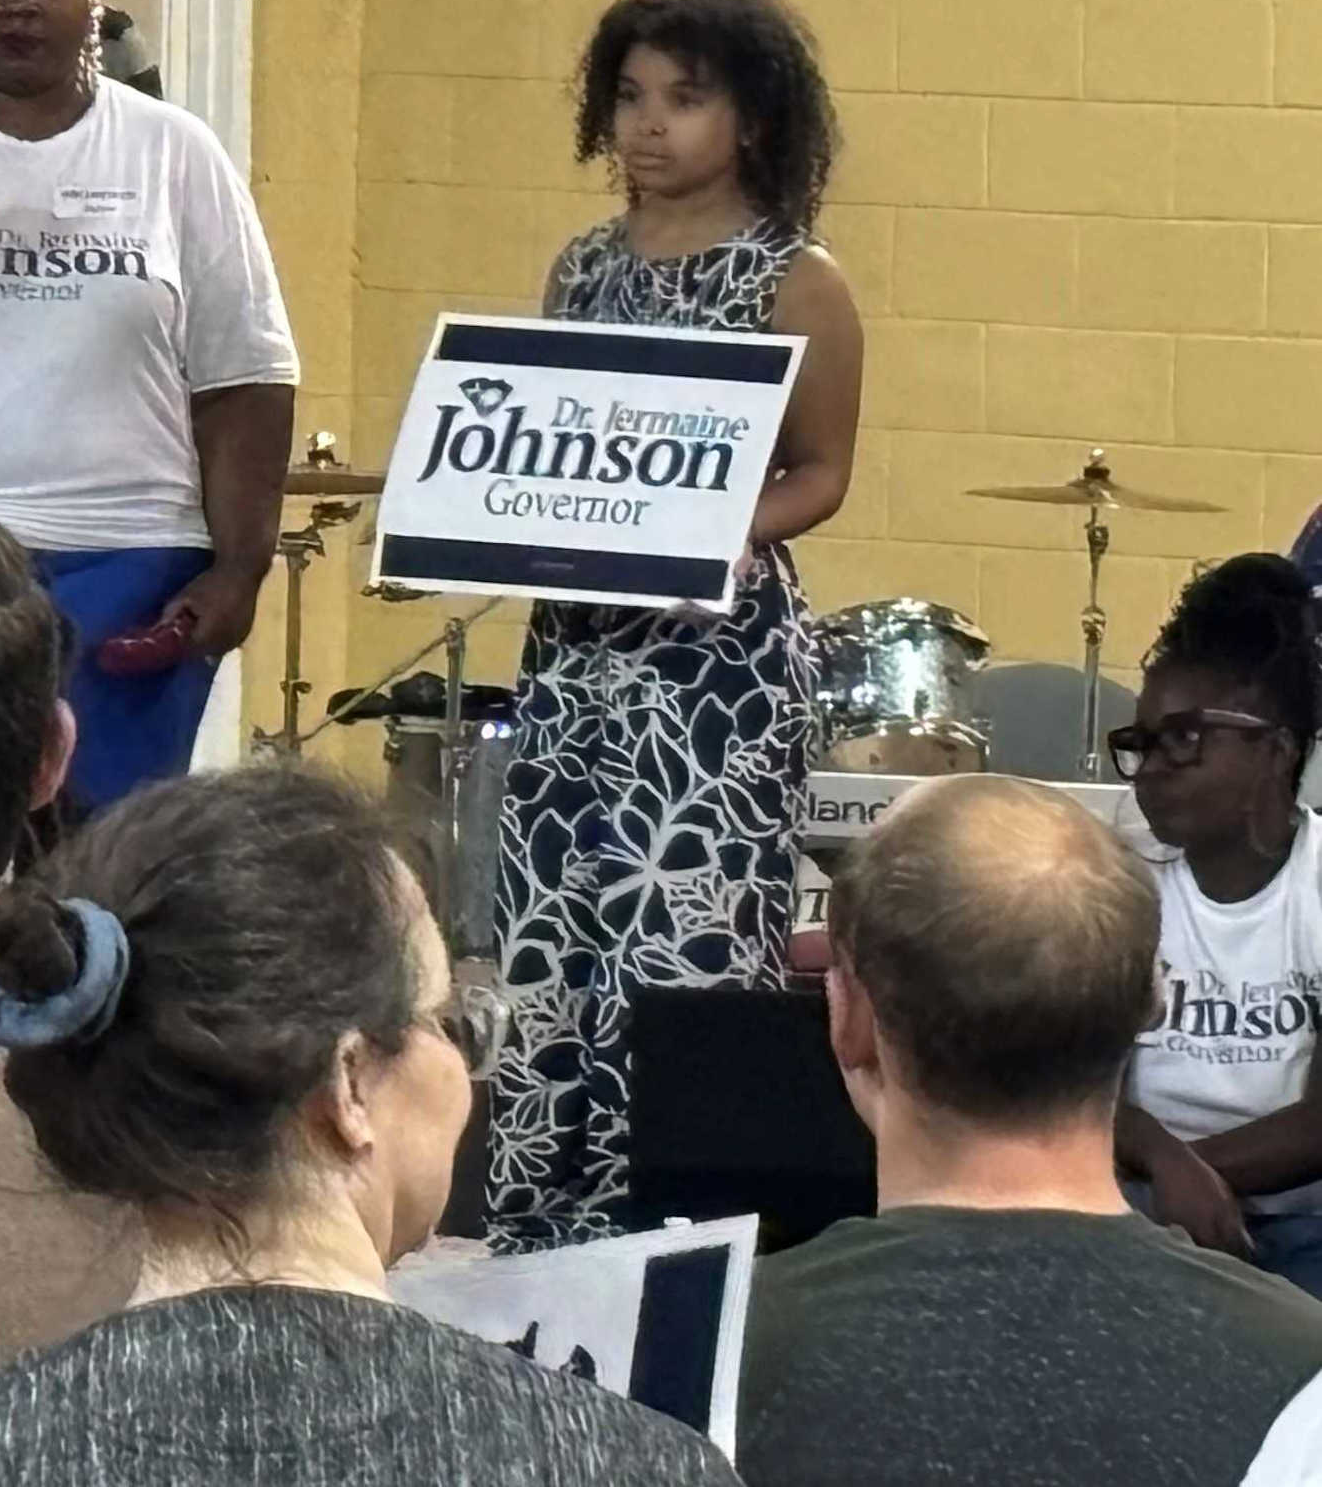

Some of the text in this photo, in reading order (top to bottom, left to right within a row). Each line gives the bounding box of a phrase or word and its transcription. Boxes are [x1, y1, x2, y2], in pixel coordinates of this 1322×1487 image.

[550, 396, 750, 441] Dr. Jermaine
[417, 404, 733, 491] Johnson
[484, 478, 652, 525] Governor
